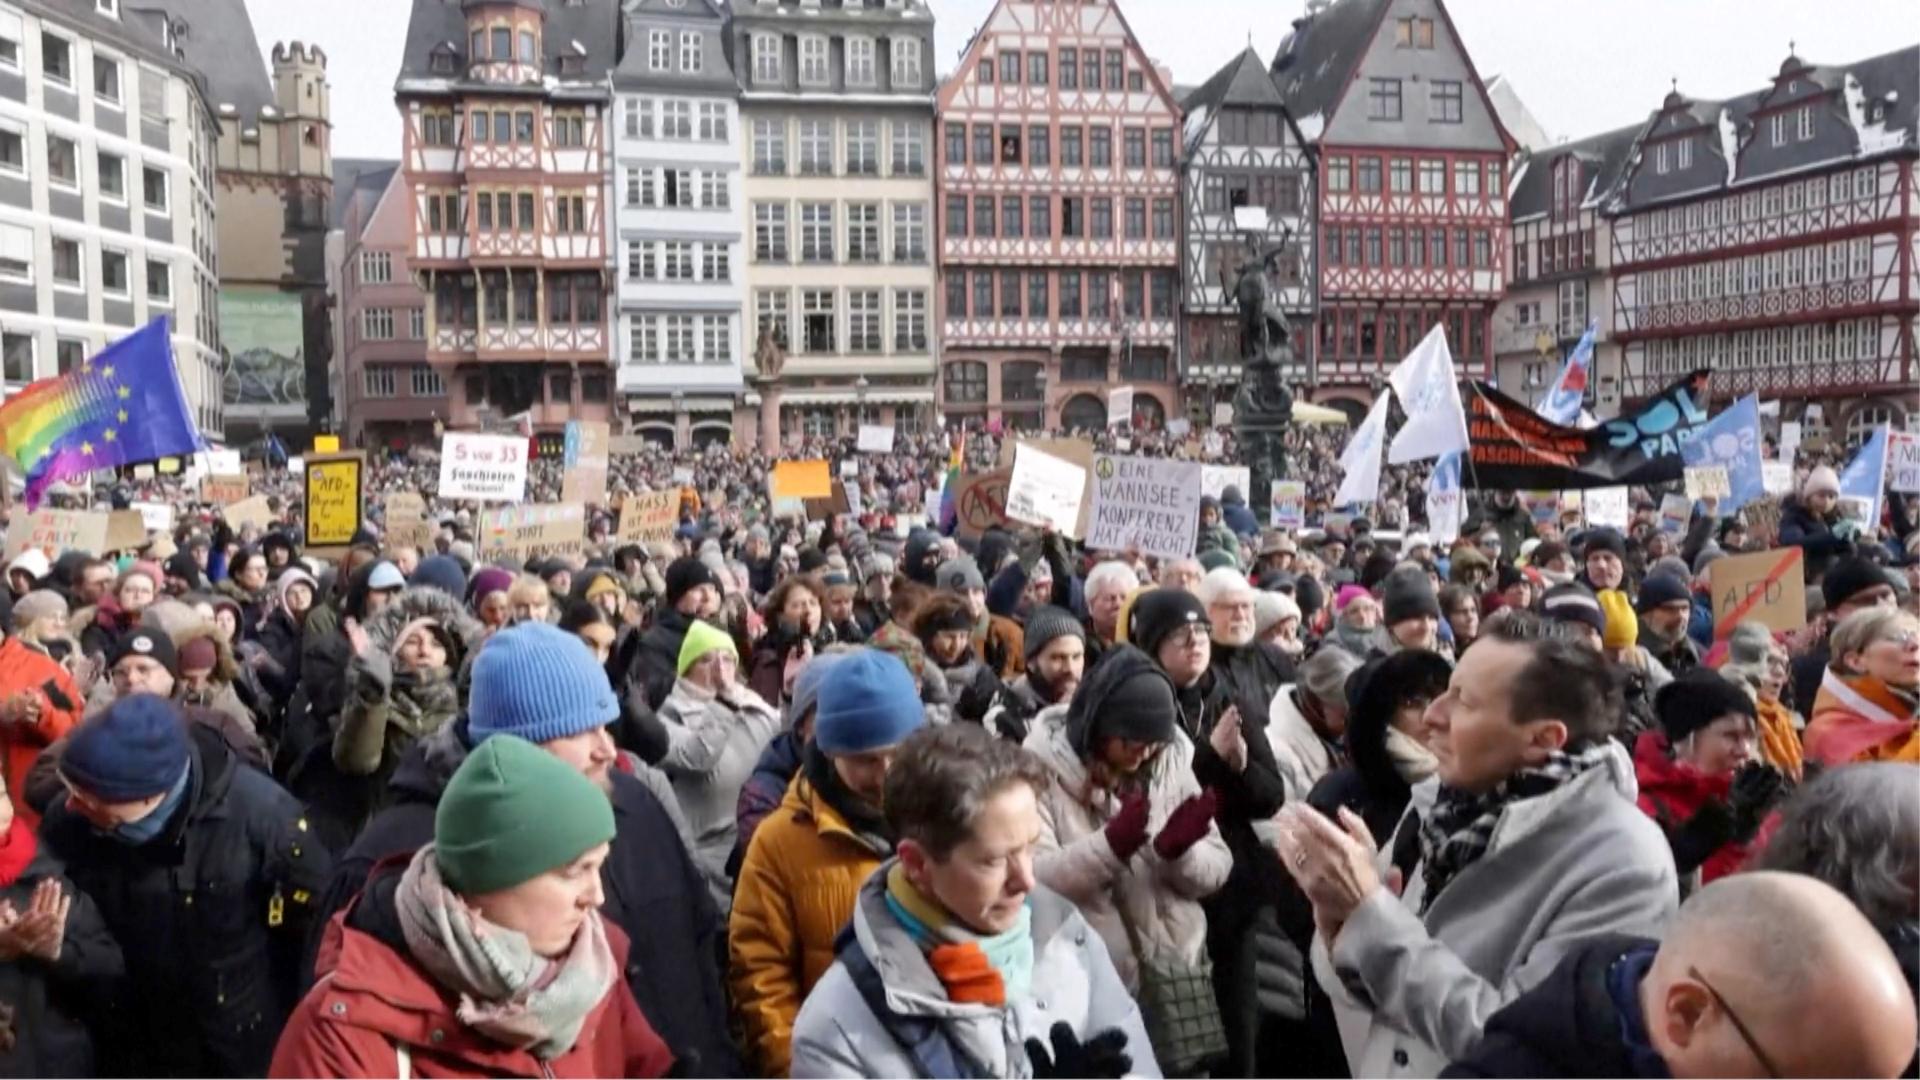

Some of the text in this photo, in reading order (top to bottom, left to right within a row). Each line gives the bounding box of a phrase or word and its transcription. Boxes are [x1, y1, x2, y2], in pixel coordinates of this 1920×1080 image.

[1119, 463, 1155, 479] EINE
[1098, 504, 1186, 534] KONFERENZ
[515, 524, 544, 540] STATT
[1093, 526, 1121, 545] HAT
[1722, 577, 1782, 612] AFD
